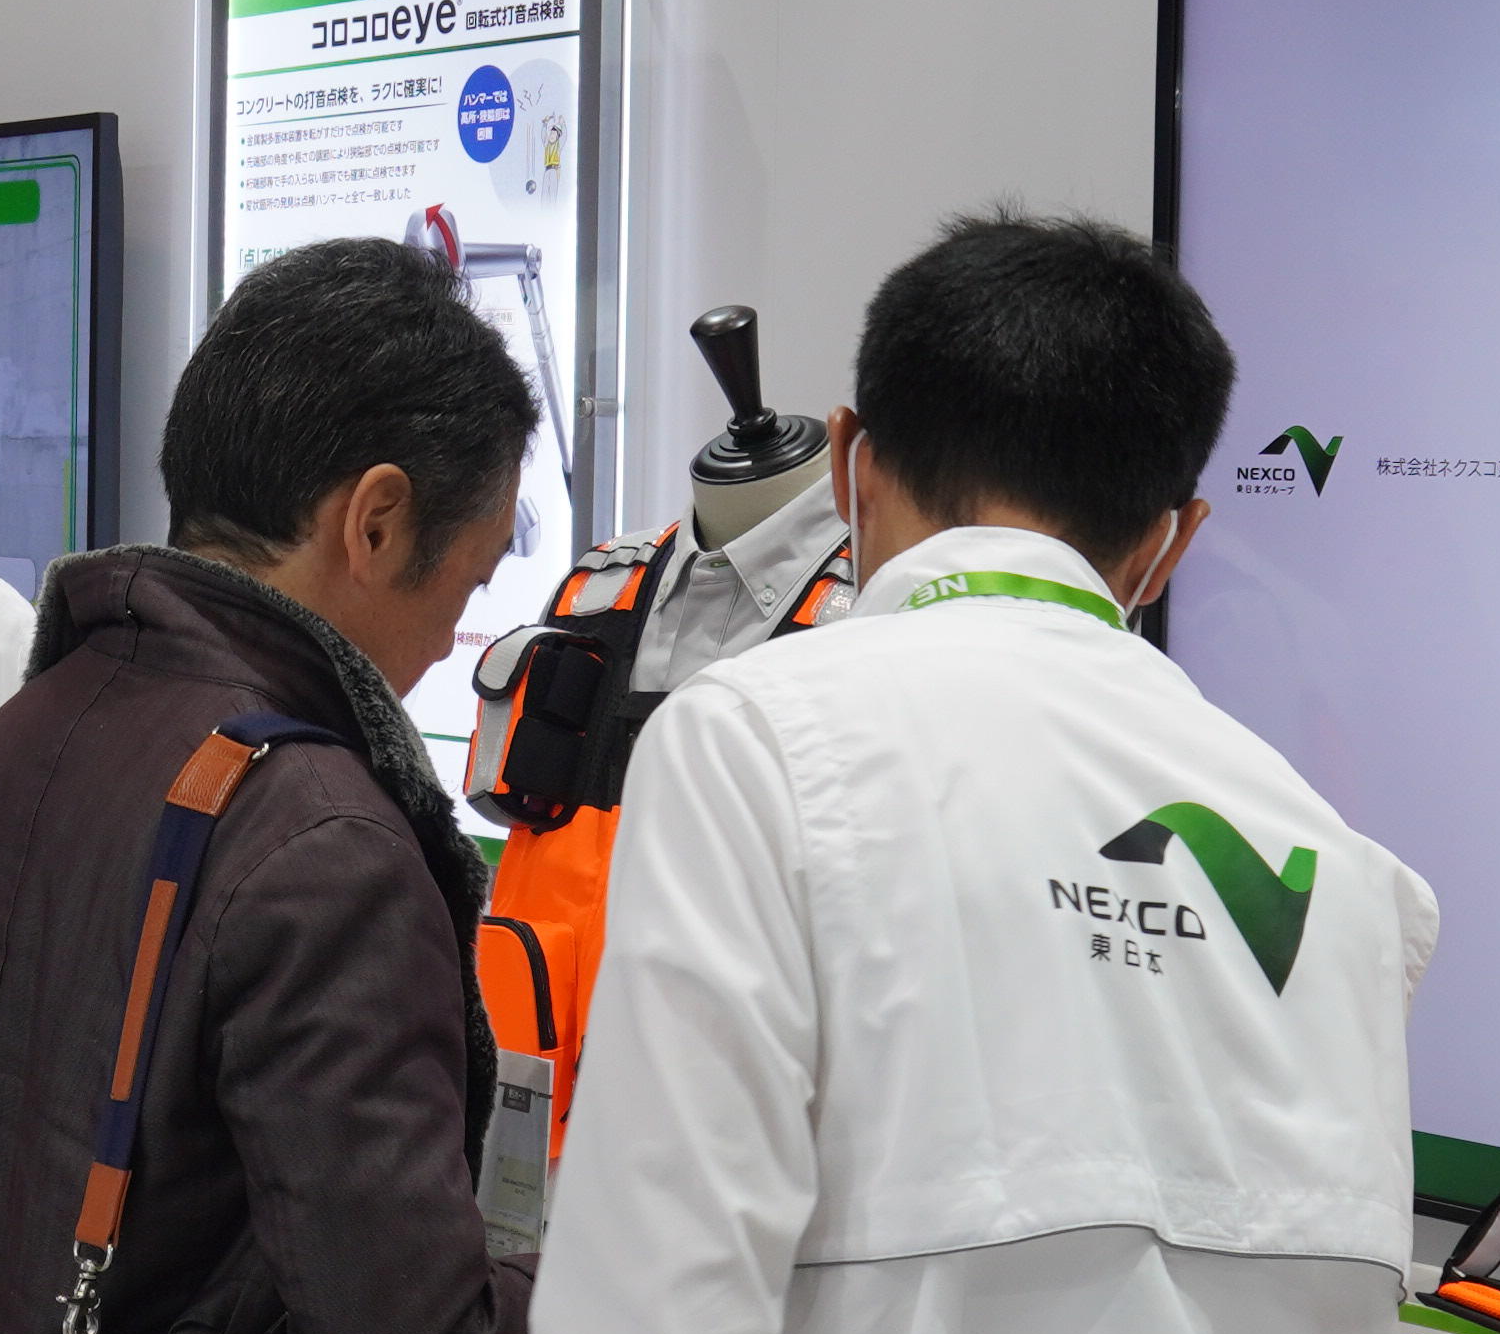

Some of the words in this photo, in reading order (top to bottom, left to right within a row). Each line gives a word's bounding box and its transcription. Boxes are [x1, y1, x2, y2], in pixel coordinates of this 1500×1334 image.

[1237, 467, 1296, 482] NEXCO
[1236, 484, 1295, 495] 東日本グループ
[1048, 878, 1206, 940] NEXCO
[1090, 934, 1165, 975] 東日本
